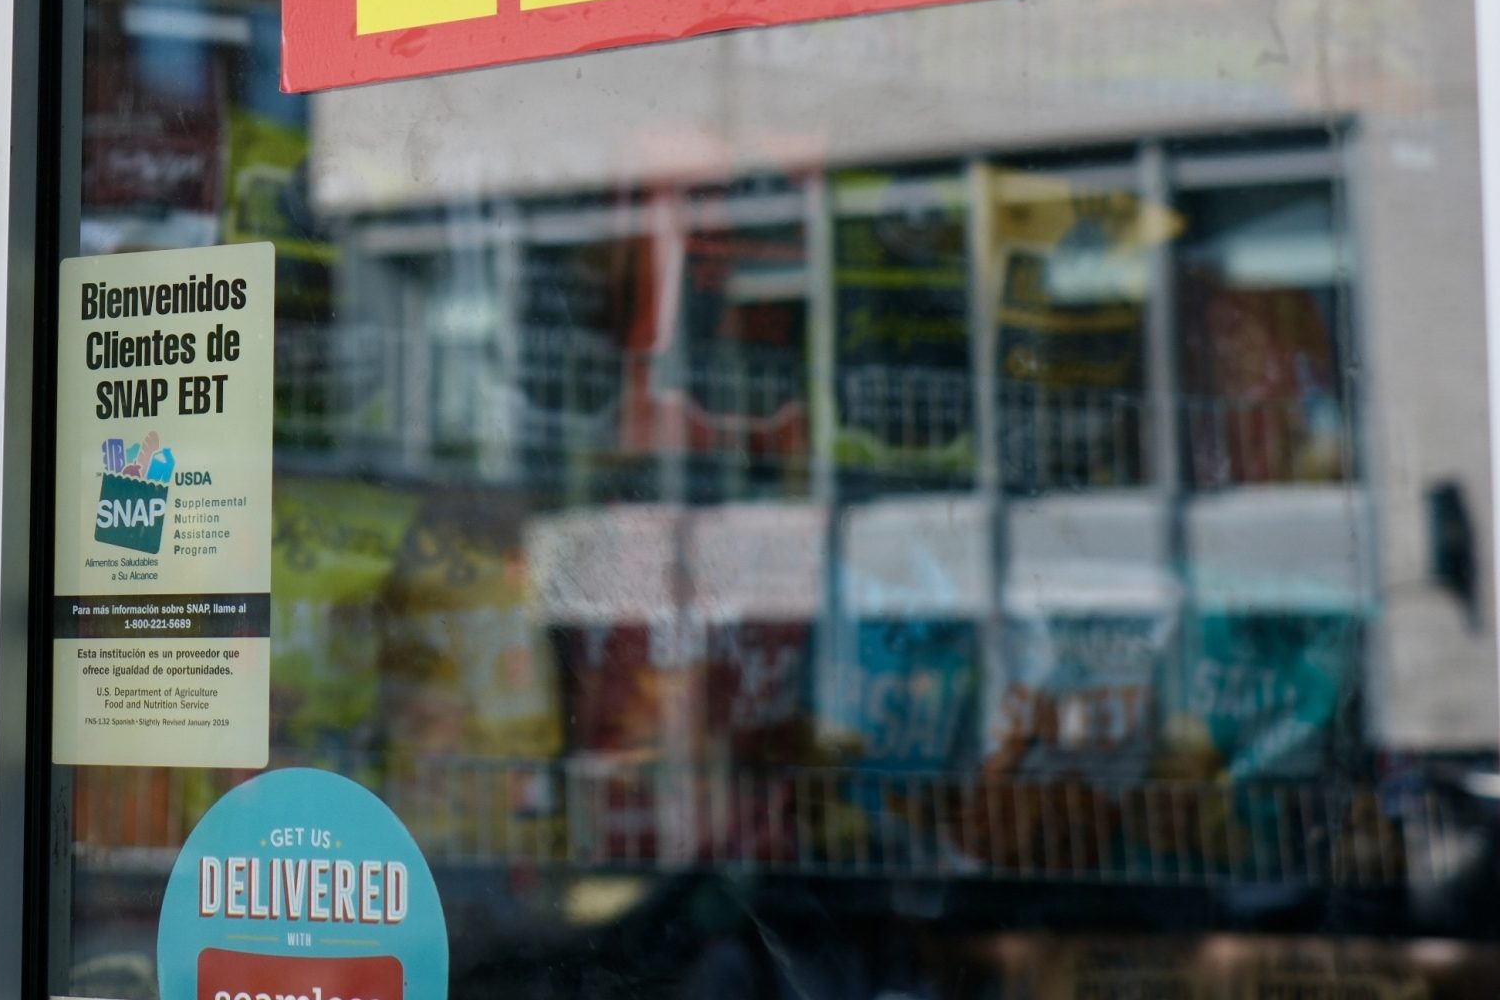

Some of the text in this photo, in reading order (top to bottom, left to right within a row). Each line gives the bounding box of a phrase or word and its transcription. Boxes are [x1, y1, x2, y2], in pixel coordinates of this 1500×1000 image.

[81, 274, 246, 320] Bienvenidos
[86, 324, 240, 370] Clientes de
[96, 375, 228, 419] SNAP EBT
[175, 471, 212, 486] USDA
[175, 497, 246, 510] Supplemental
[97, 498, 166, 529] SNAP
[175, 513, 219, 524] Nutrition
[174, 529, 230, 539] Assistance
[174, 545, 217, 557] Program
[85, 557, 158, 568] Alimentos Saludables
[118, 572, 128, 581] Su
[129, 571, 158, 580] Alcance
[72, 603, 246, 616] Para más información sobre SNAP, llame al
[124, 619, 191, 629] 1-800-221-5689
[77, 648, 239, 661] Esta institución es un proveedor que
[82, 665, 233, 677] ofrece igualdad de oportunidades.
[96, 687, 218, 698] U.S. Department of Agriculture
[104, 700, 209, 709] Food and Nutrition Service
[162, 718, 185, 727] Revised
[187, 719, 210, 728] January
[212, 719, 230, 727] 2019
[270, 827, 331, 849] GET US
[199, 856, 409, 924] DELIVERED
[287, 932, 312, 947] WITH
